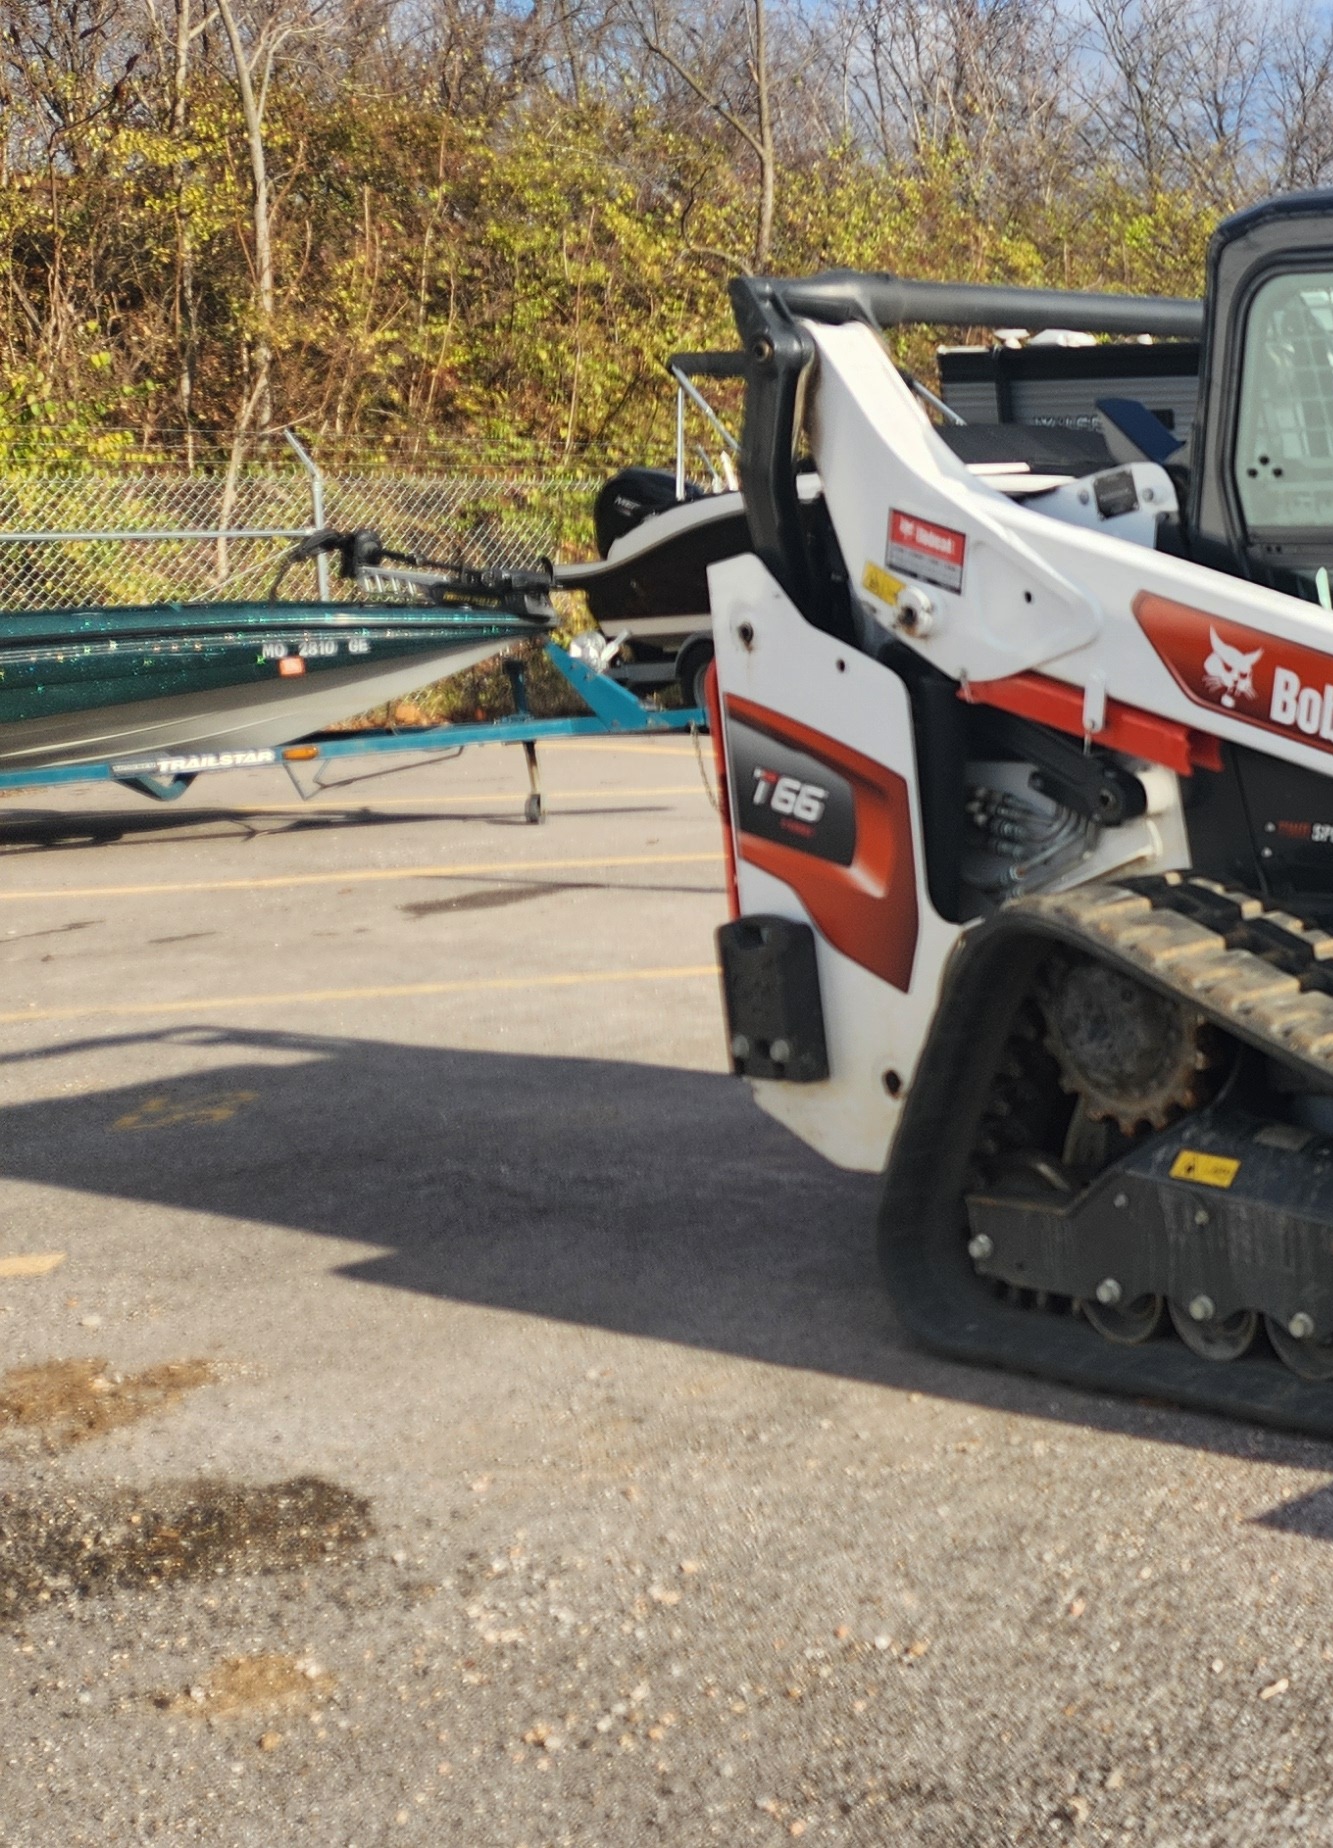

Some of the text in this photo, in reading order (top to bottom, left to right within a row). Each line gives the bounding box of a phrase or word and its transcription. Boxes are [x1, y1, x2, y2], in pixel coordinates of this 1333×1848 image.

[262, 643, 287, 658] MO
[158, 748, 276, 773] TRAILSTAR
[753, 766, 829, 823] T66
